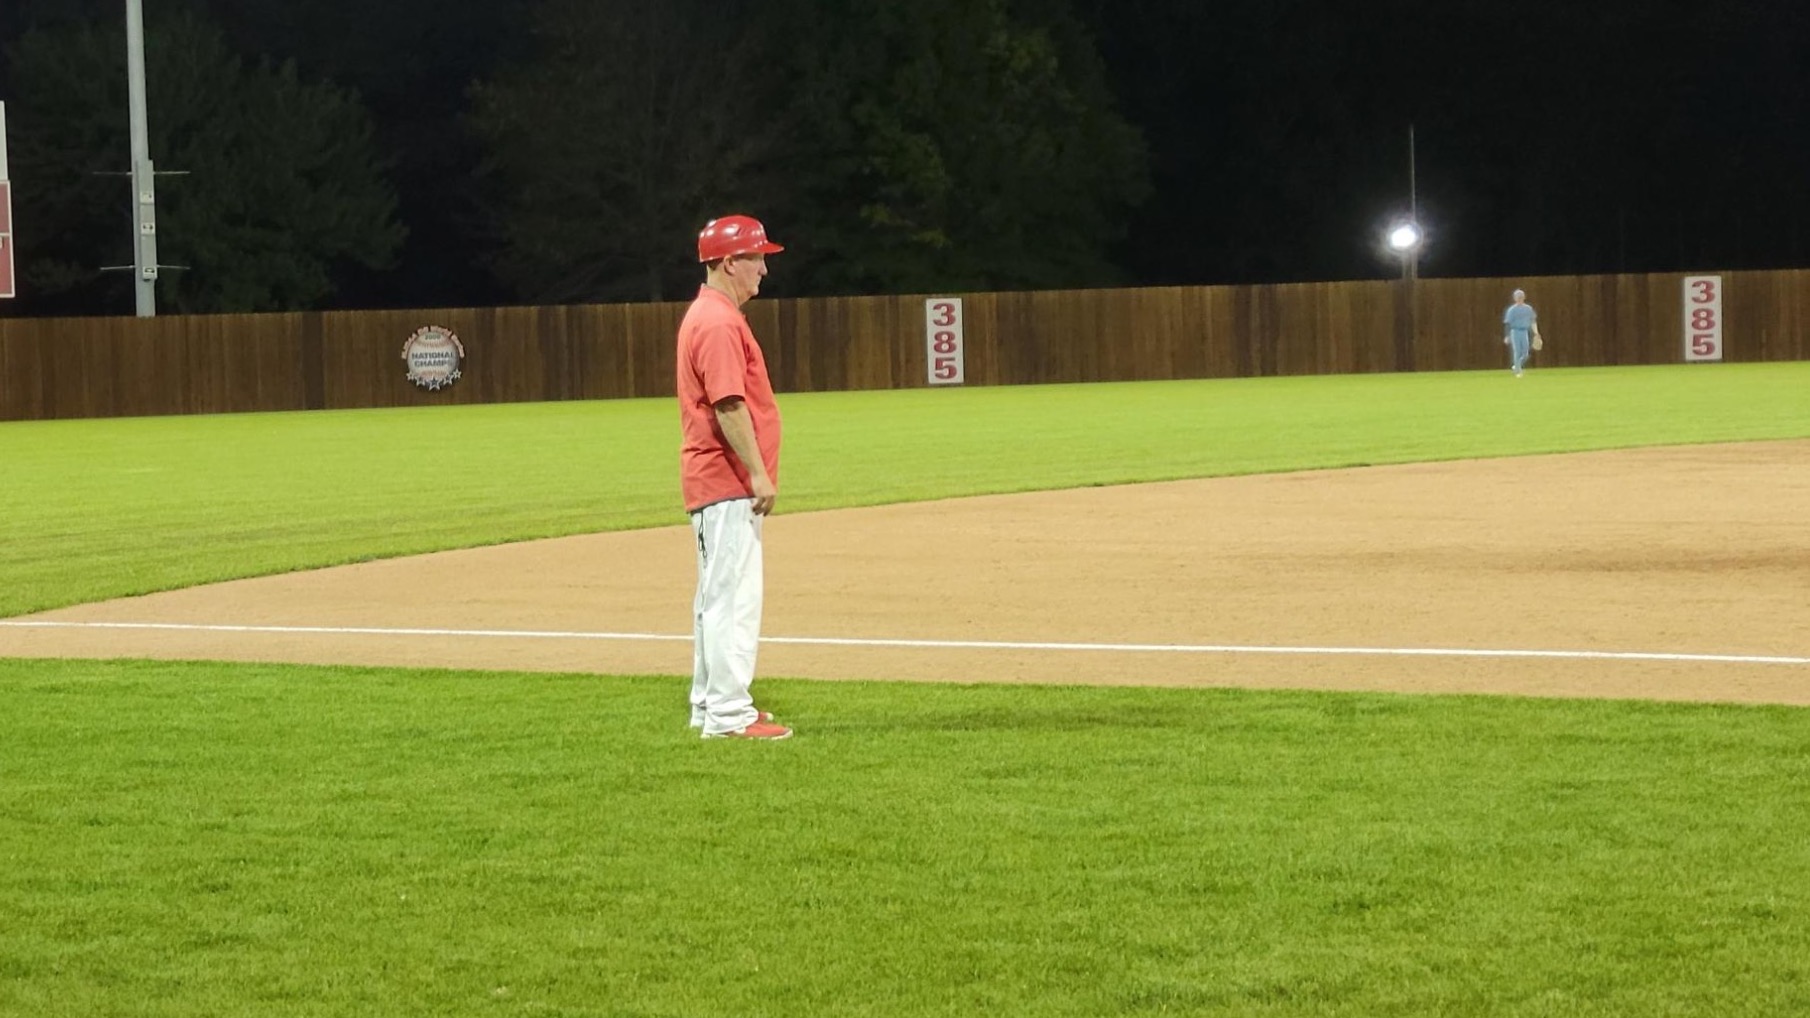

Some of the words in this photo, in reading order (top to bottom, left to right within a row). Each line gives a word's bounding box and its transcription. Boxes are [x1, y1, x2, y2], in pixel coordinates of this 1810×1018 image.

[411, 351, 454, 360] NATIONAL
[932, 302, 957, 380] 385
[1691, 280, 1716, 356] 385
